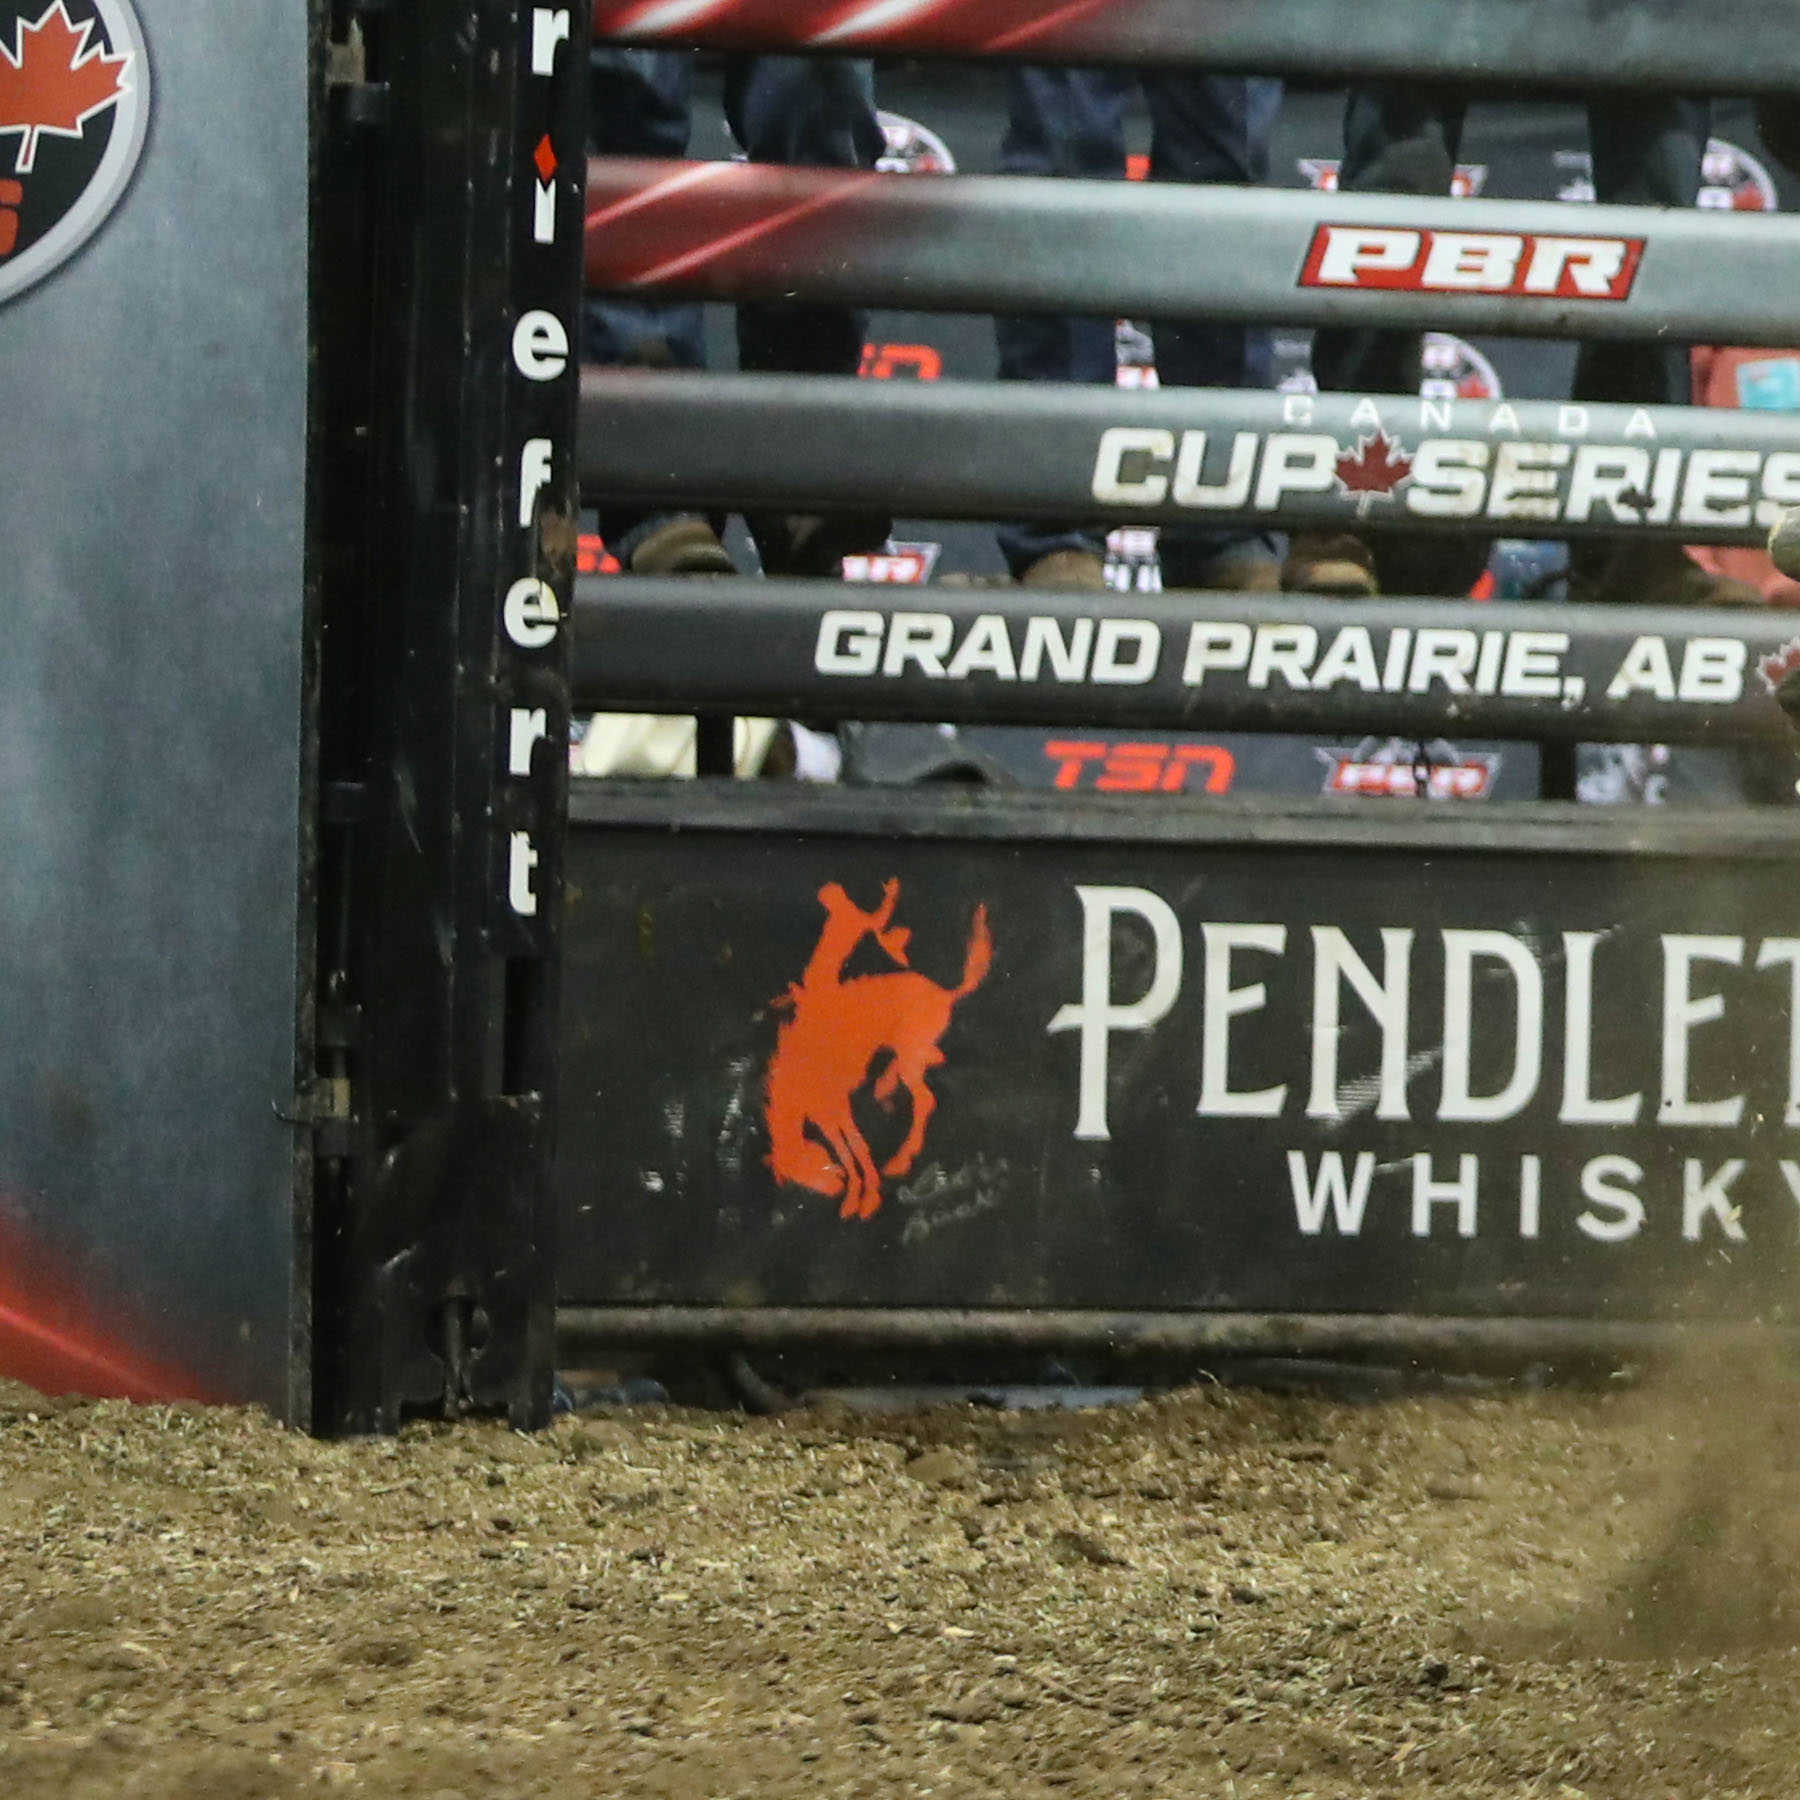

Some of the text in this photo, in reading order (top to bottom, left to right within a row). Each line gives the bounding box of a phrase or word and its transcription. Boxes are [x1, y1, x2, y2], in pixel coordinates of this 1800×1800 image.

[1318, 226, 1629, 295] PBR
[1283, 394, 1657, 439] CANADA
[1091, 427, 1338, 511] CUP
[813, 609, 1748, 706] GRAND PRAIRIE, AB
[1043, 739, 1236, 795] TSN
